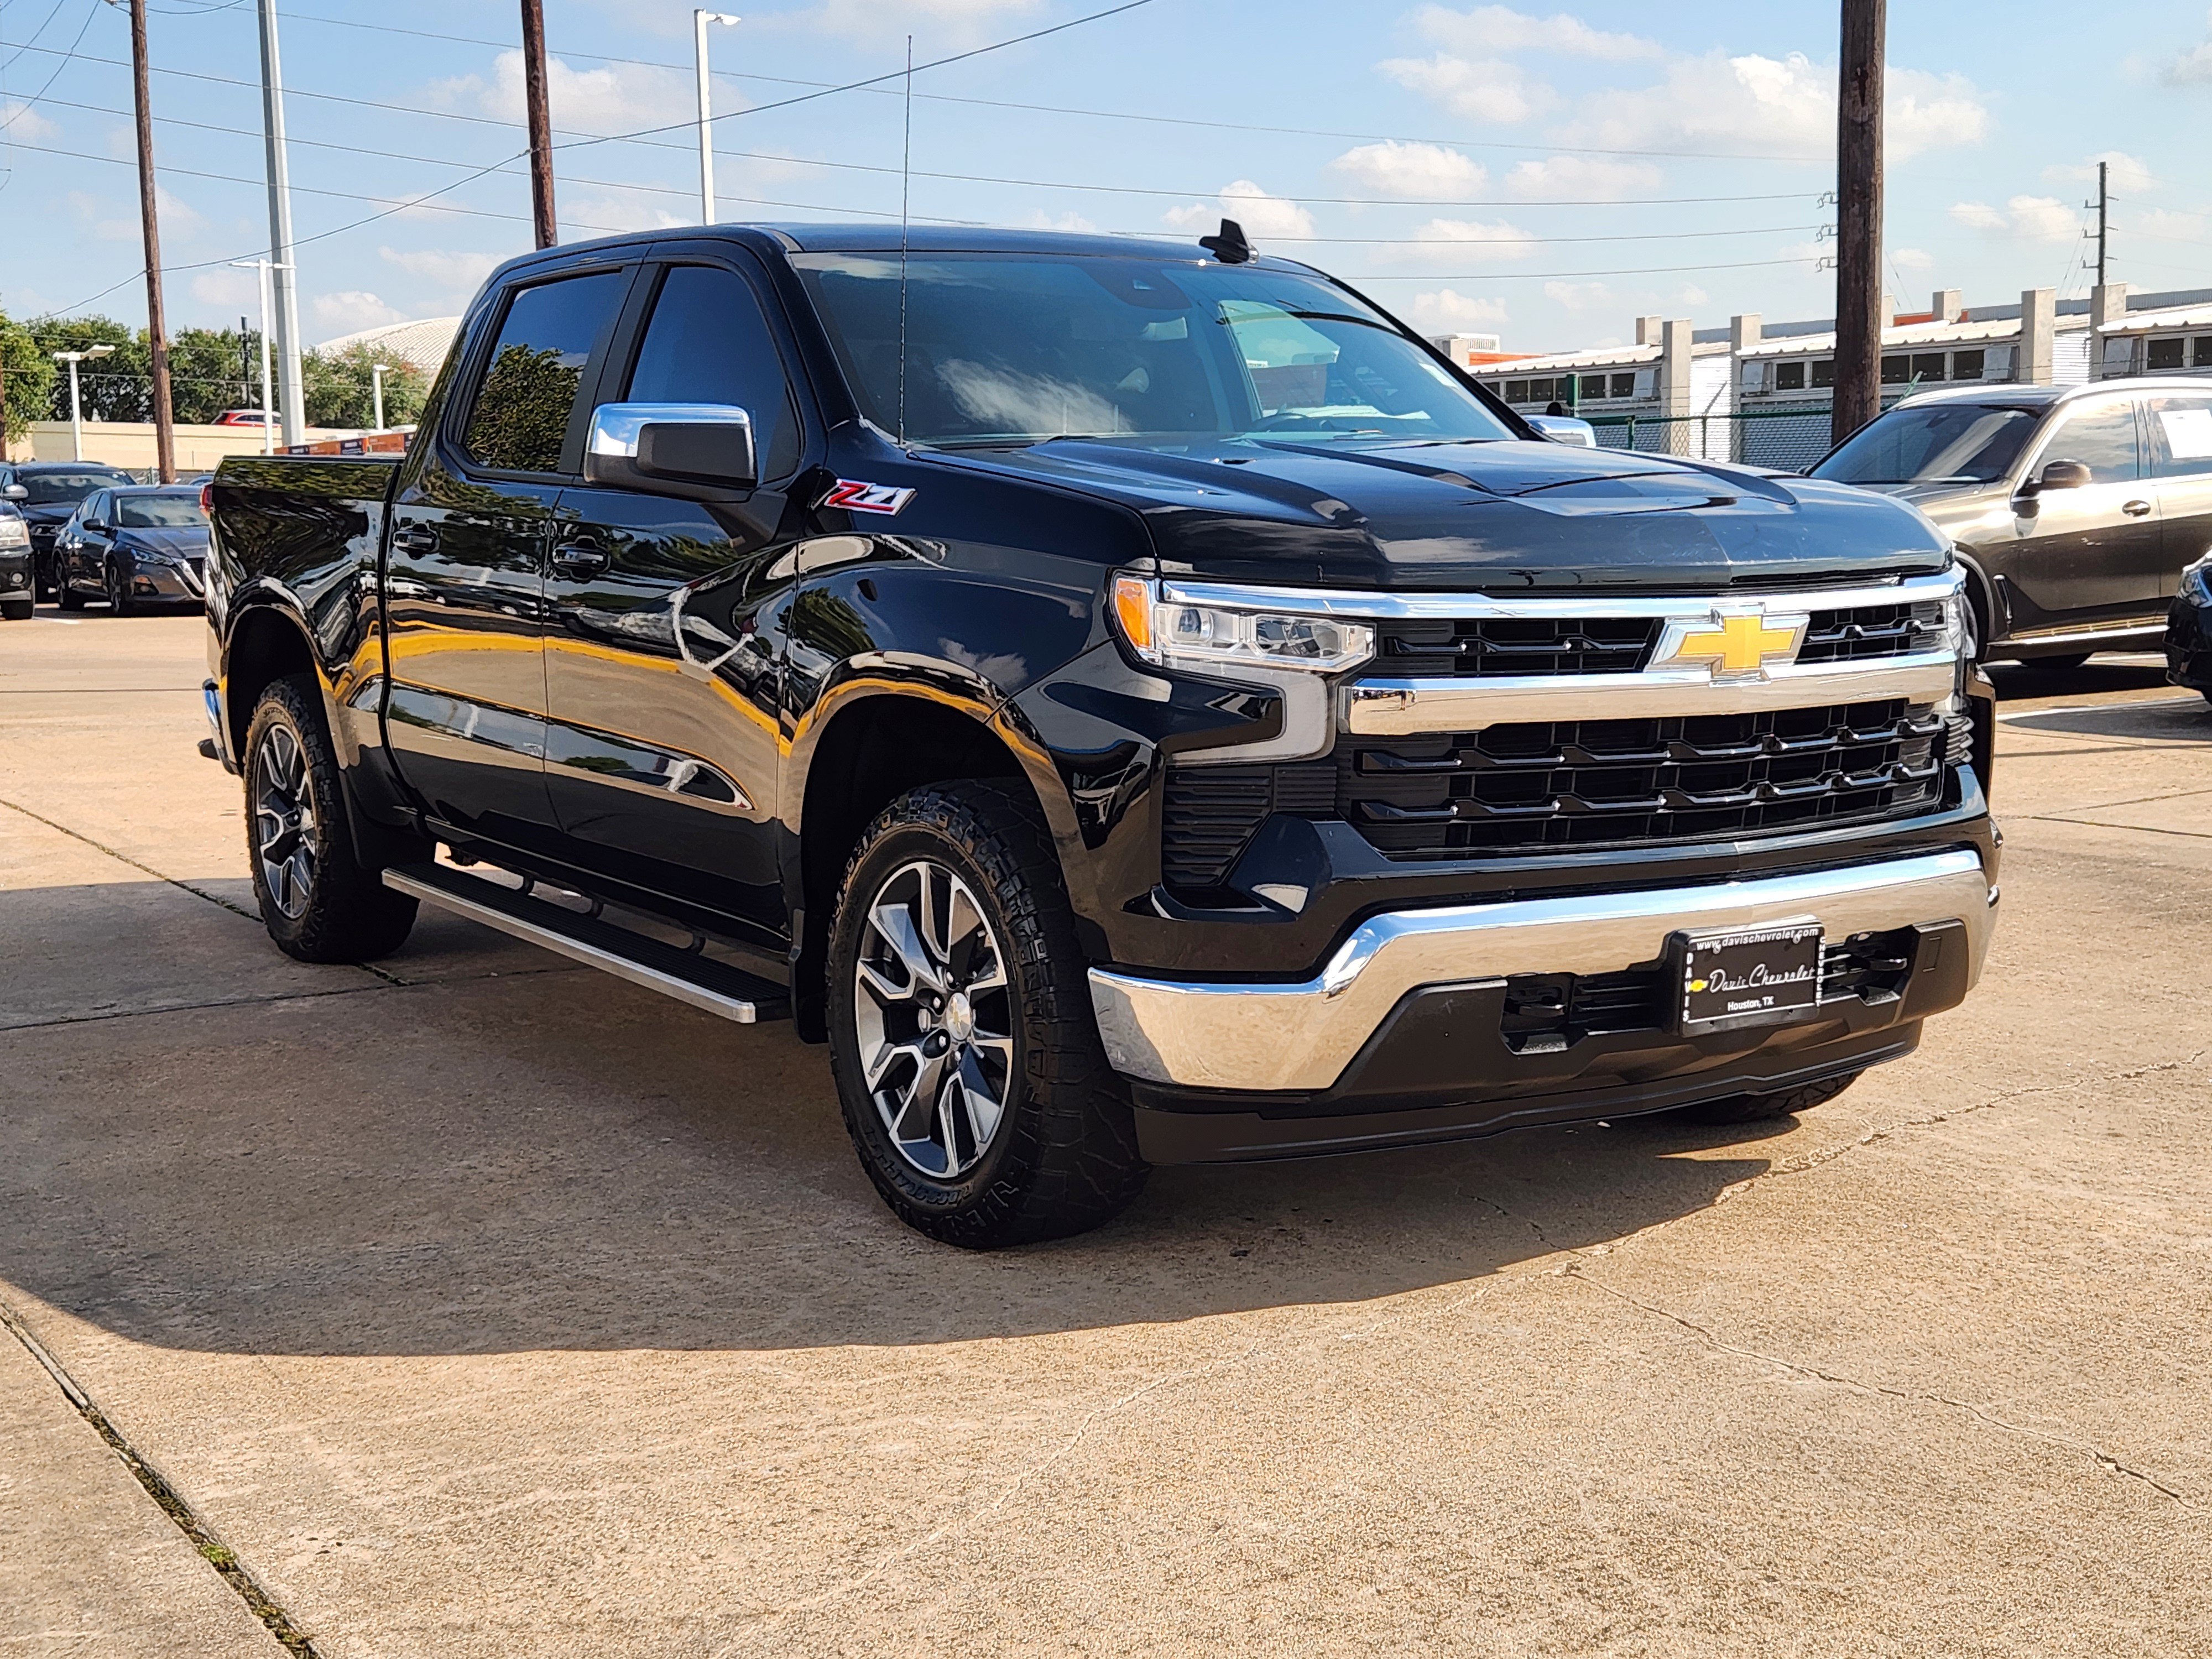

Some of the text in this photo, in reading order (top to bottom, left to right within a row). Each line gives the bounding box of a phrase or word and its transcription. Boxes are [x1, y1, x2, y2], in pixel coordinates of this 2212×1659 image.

[1683, 952, 1694, 1022] DAVIS
[1709, 963, 1816, 993] Davis Chevrolet
[1815, 936, 1826, 1007] CHEVROLET
[1728, 996, 1775, 1011] Houston, TX
